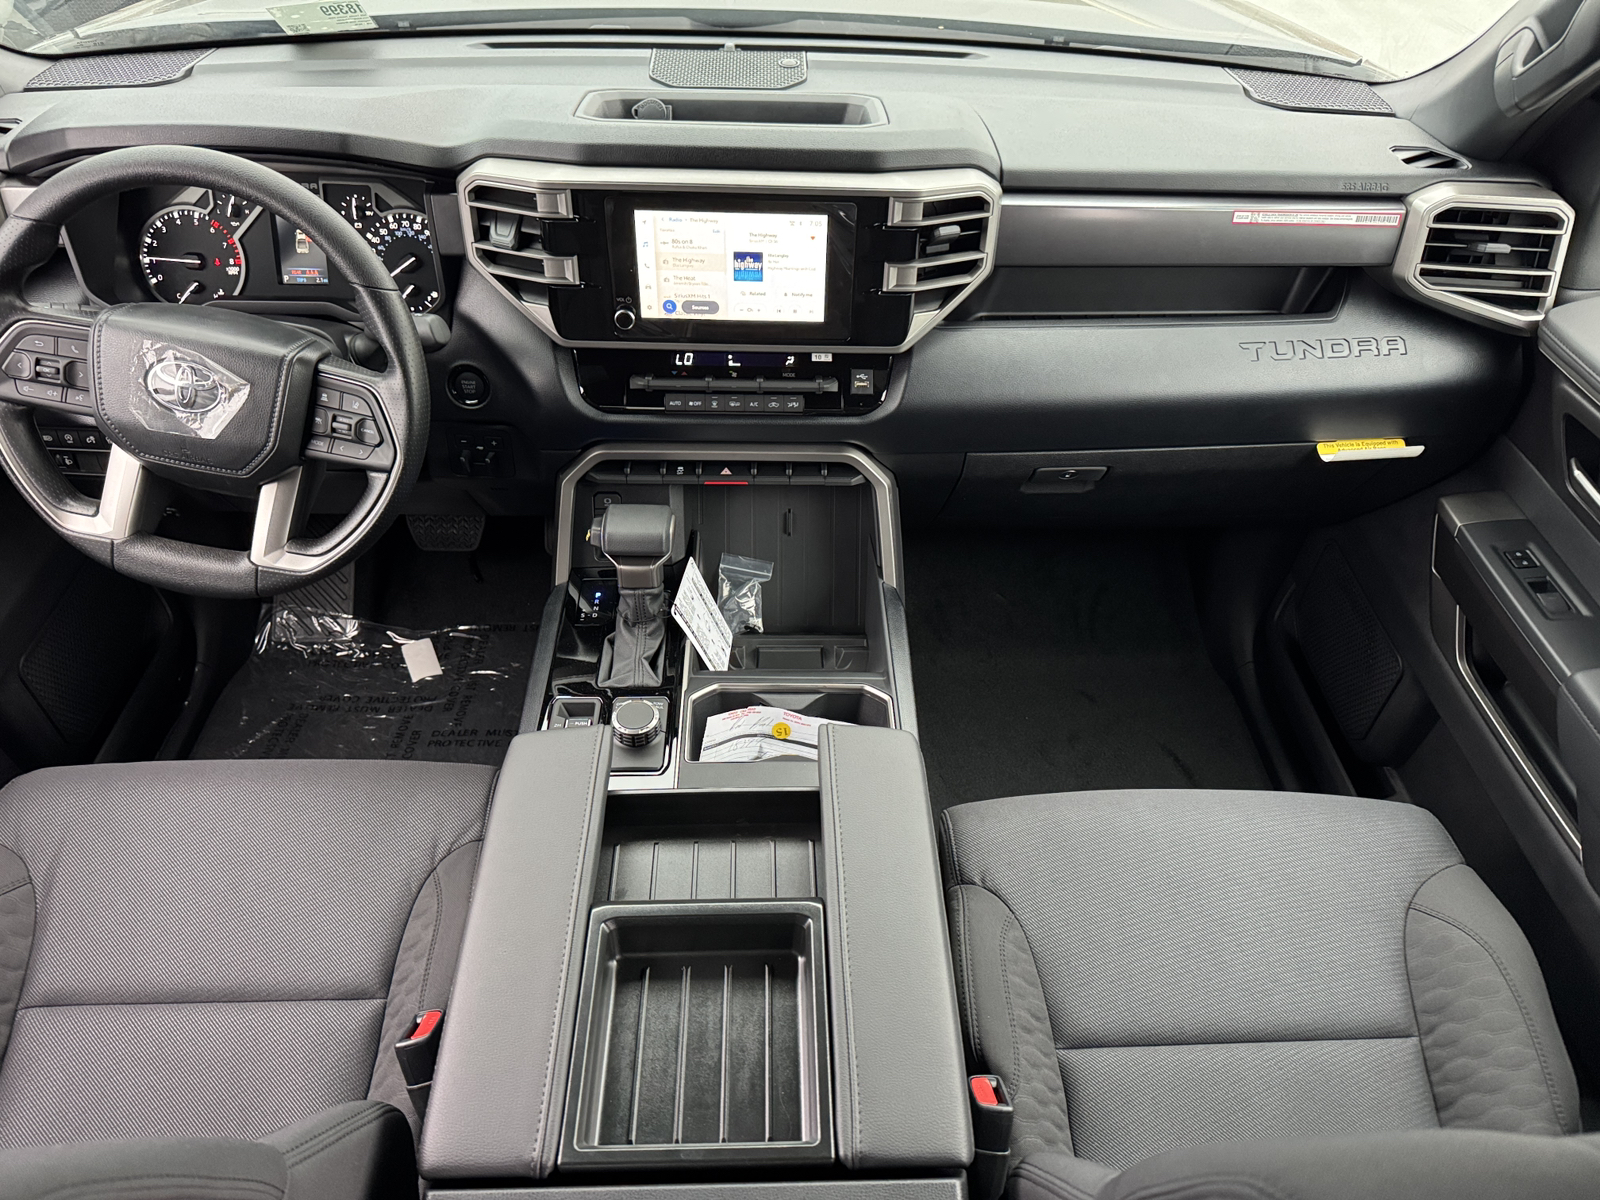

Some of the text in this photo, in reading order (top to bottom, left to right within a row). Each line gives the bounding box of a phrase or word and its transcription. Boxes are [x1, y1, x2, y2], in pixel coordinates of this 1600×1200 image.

[734, 259, 762, 270] highway
[1239, 336, 1408, 362] TUNDRA
[784, 712, 802, 720] TOYOTA
[776, 728, 788, 736] 15
